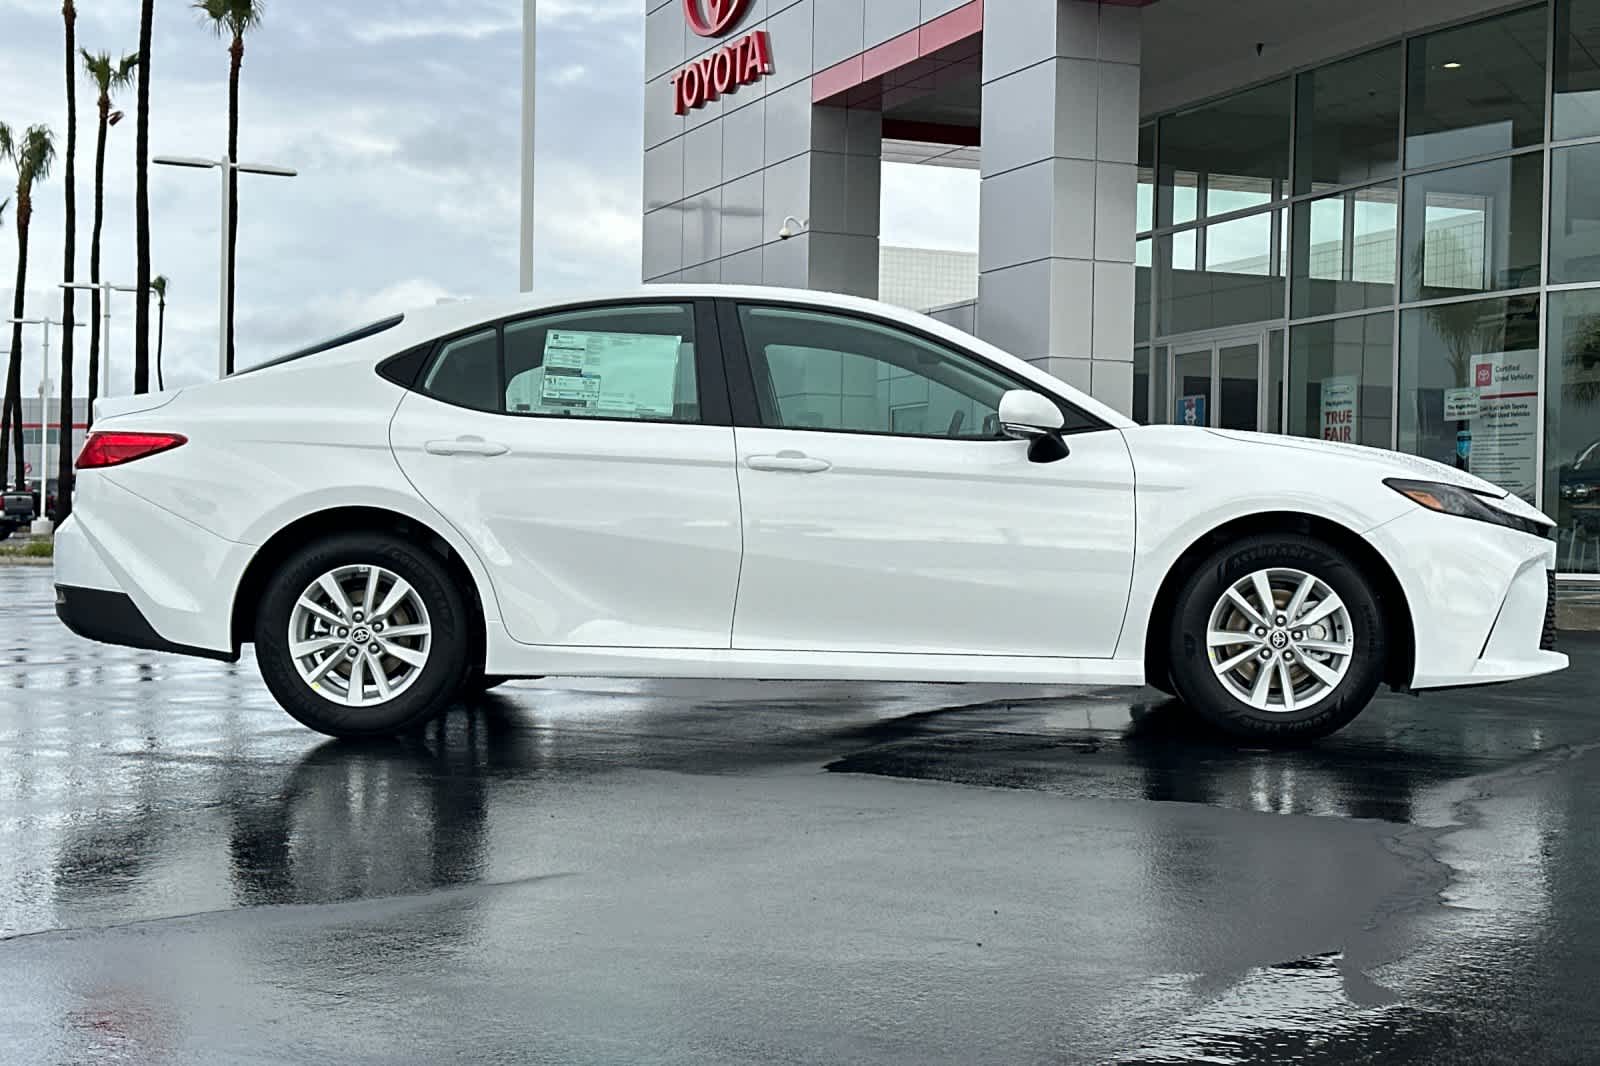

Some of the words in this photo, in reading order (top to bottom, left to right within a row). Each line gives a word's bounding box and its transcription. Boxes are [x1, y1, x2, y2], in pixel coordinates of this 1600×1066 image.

[671, 31, 769, 115] TOYOTA
[1325, 409, 1352, 424] TRUE
[1324, 426, 1351, 442] FAIR
